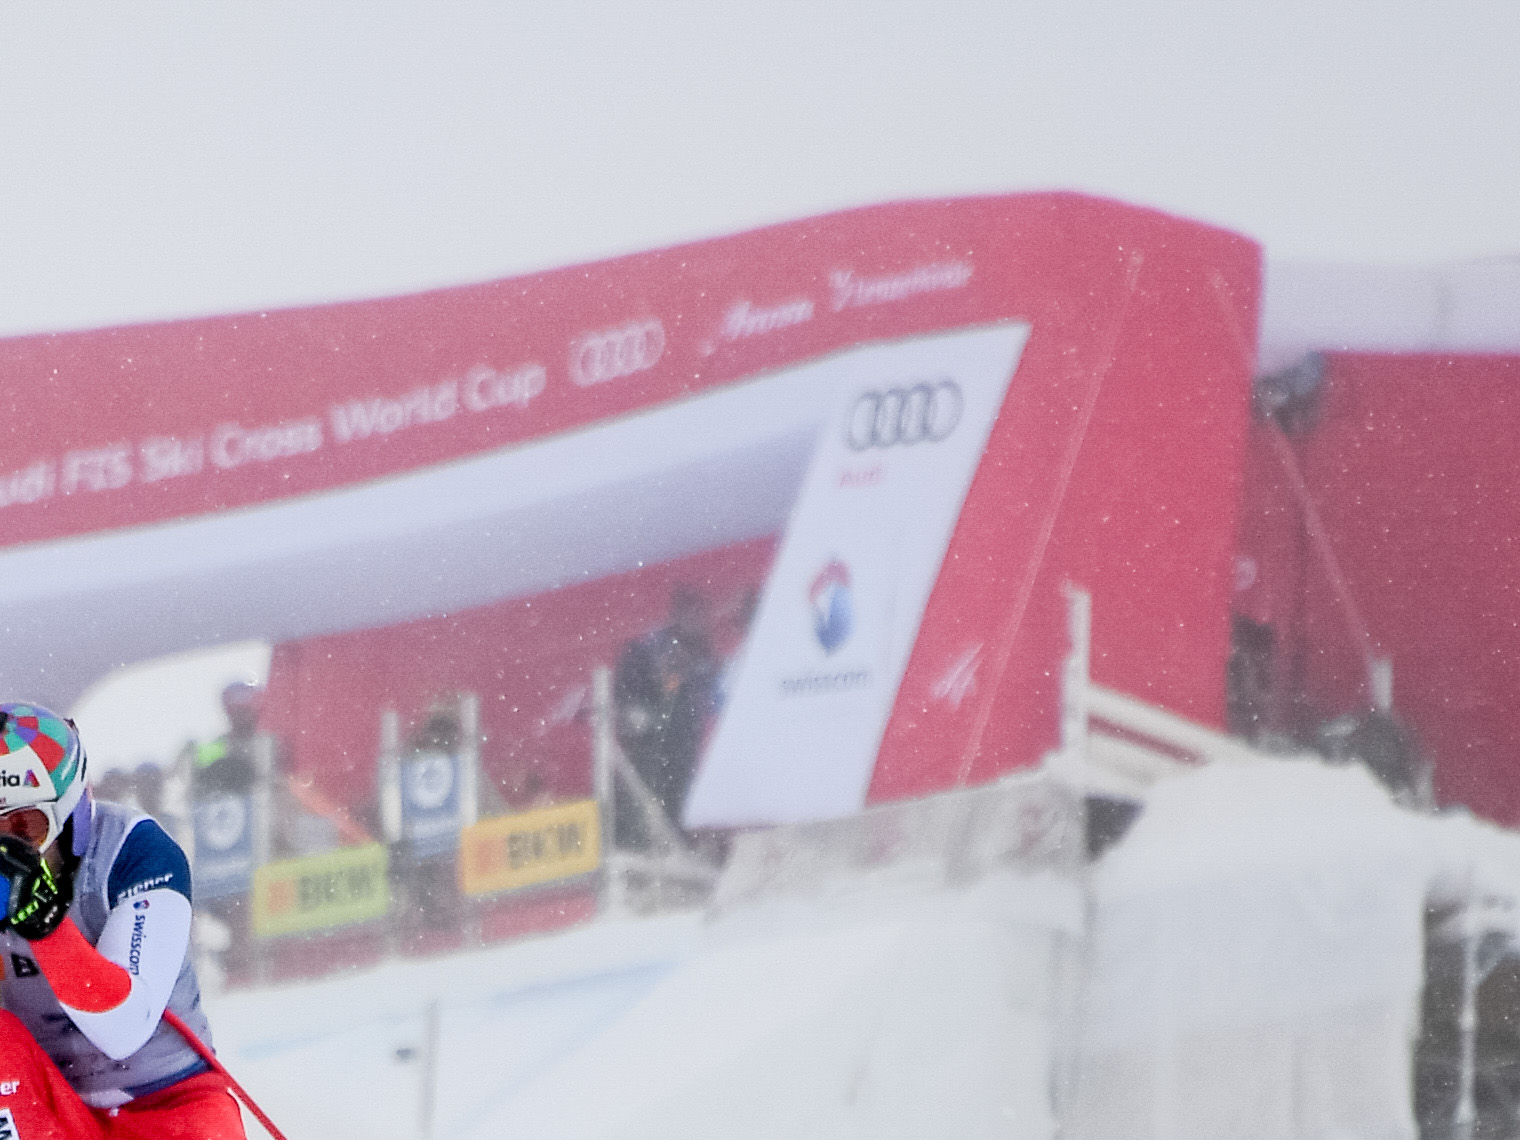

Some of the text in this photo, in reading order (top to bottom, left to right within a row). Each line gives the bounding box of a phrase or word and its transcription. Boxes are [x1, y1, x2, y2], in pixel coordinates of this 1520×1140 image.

[61, 446, 131, 494] FIS
[140, 435, 202, 483] Ski
[212, 421, 322, 469] Cross
[332, 383, 457, 442] World
[464, 362, 547, 411] Cup
